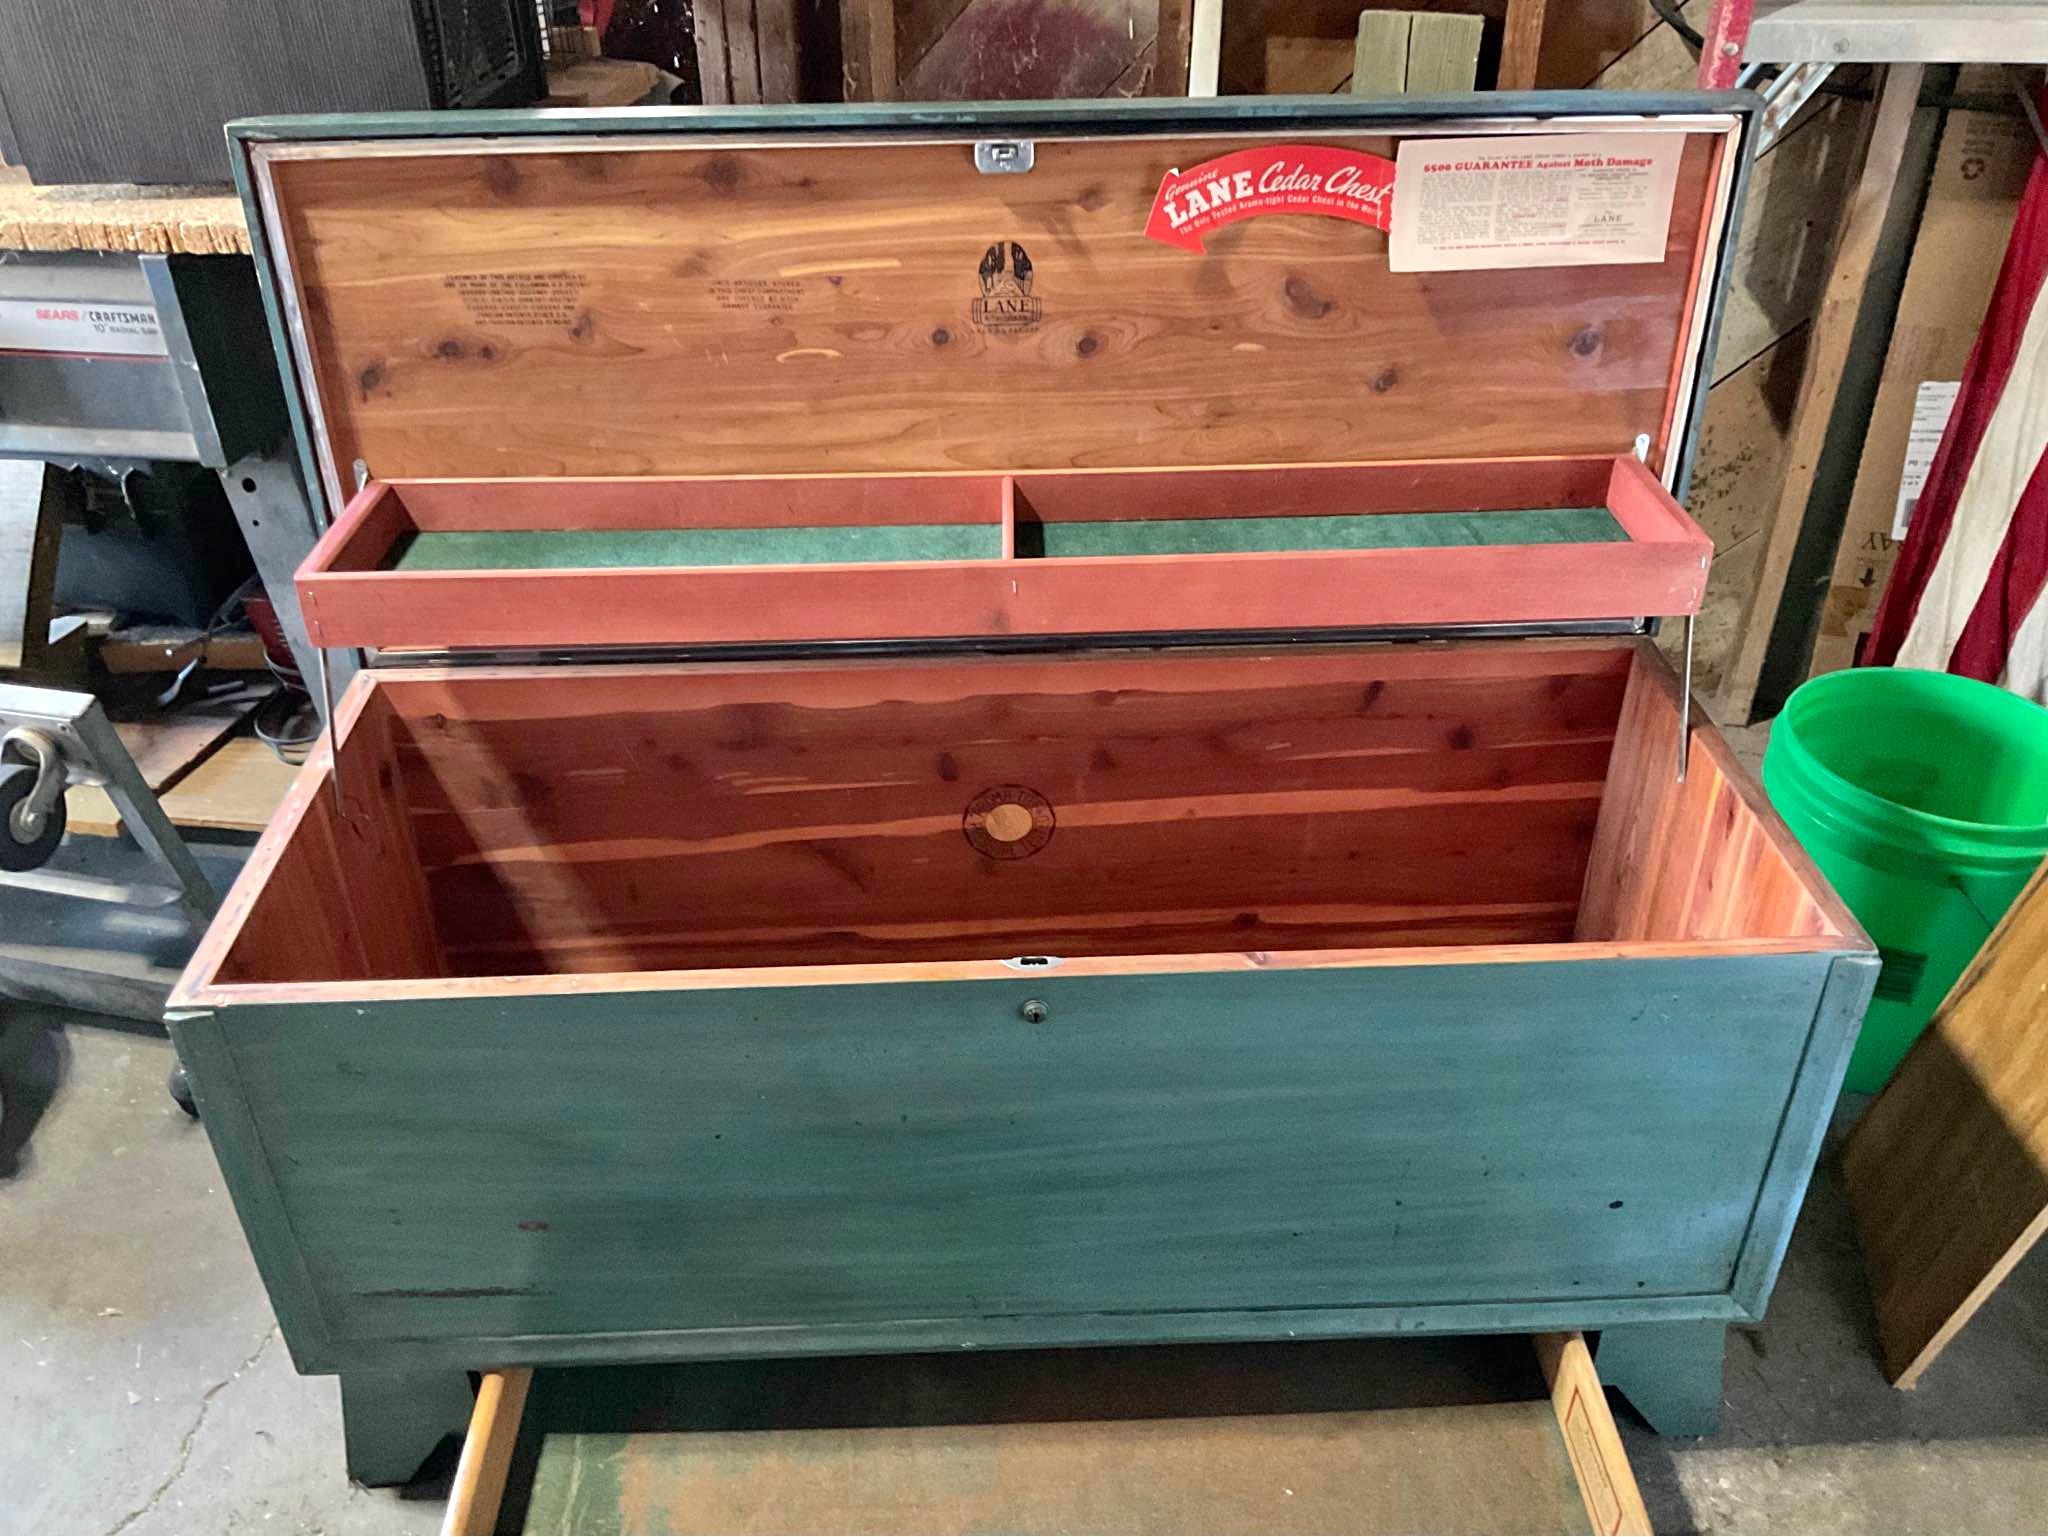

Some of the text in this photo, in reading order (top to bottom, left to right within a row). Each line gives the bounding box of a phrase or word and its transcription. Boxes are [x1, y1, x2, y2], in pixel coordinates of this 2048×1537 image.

[1455, 160, 1533, 172] GUARANTEE
[1574, 159, 1603, 168] Moth
[1607, 157, 1653, 167] Damage
[1162, 160, 1393, 229] LANE Cedar Chest
[1593, 215, 1623, 223] LANE
[984, 300, 1034, 313] LANE
[36, 308, 156, 324] SEARS CRAFTSMAN
